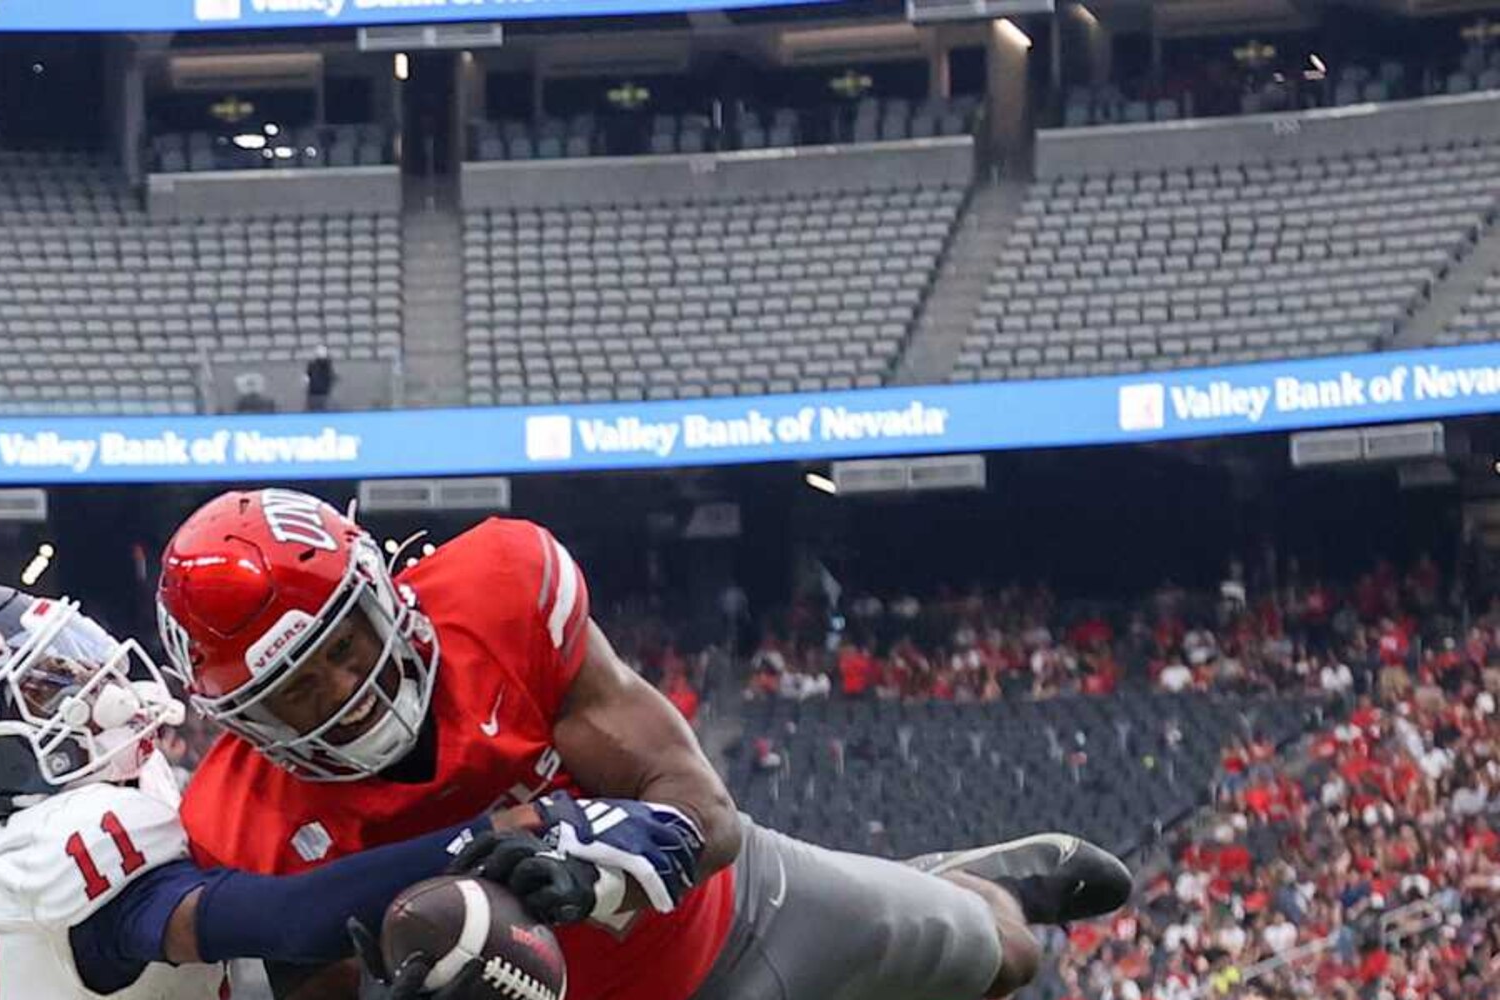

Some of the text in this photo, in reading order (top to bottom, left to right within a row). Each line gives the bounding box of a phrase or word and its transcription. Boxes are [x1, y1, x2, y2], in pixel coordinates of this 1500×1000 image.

[1171, 380, 1270, 422] Valley
[1275, 371, 1366, 411] Bank
[1369, 365, 1406, 402] of
[100, 431, 190, 465] Bank
[191, 429, 230, 463] of
[235, 426, 360, 462] Nevada
[578, 400, 948, 457] Valley Bank of Nevada
[254, 620, 307, 668] VEGAS
[65, 810, 146, 901] 11
